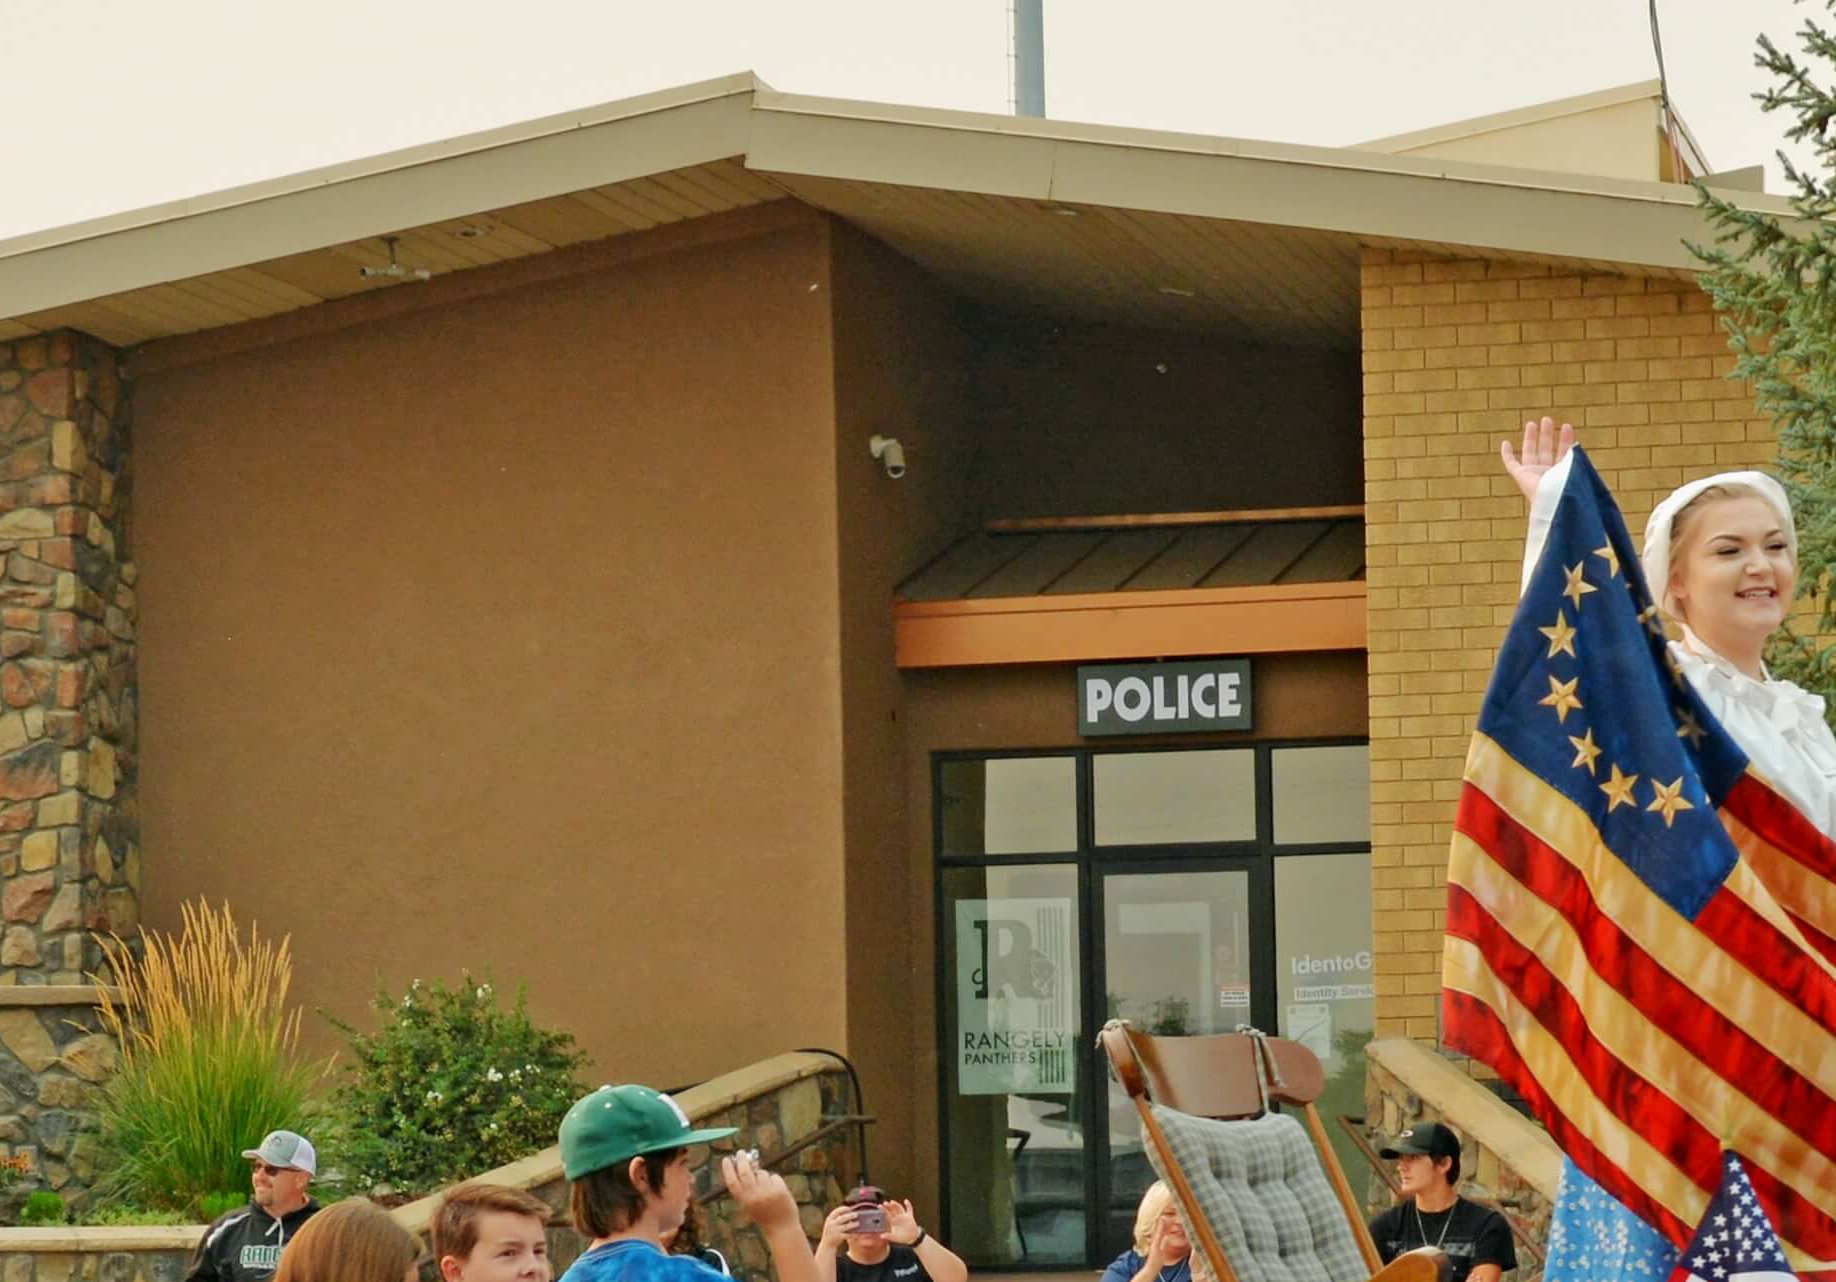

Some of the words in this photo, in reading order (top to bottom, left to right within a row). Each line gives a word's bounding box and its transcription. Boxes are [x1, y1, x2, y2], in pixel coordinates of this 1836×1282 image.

[1086, 672, 1242, 723] POLICE
[964, 1030, 1066, 1049] RANGELY
[964, 1052, 1037, 1065] PANTHERS
